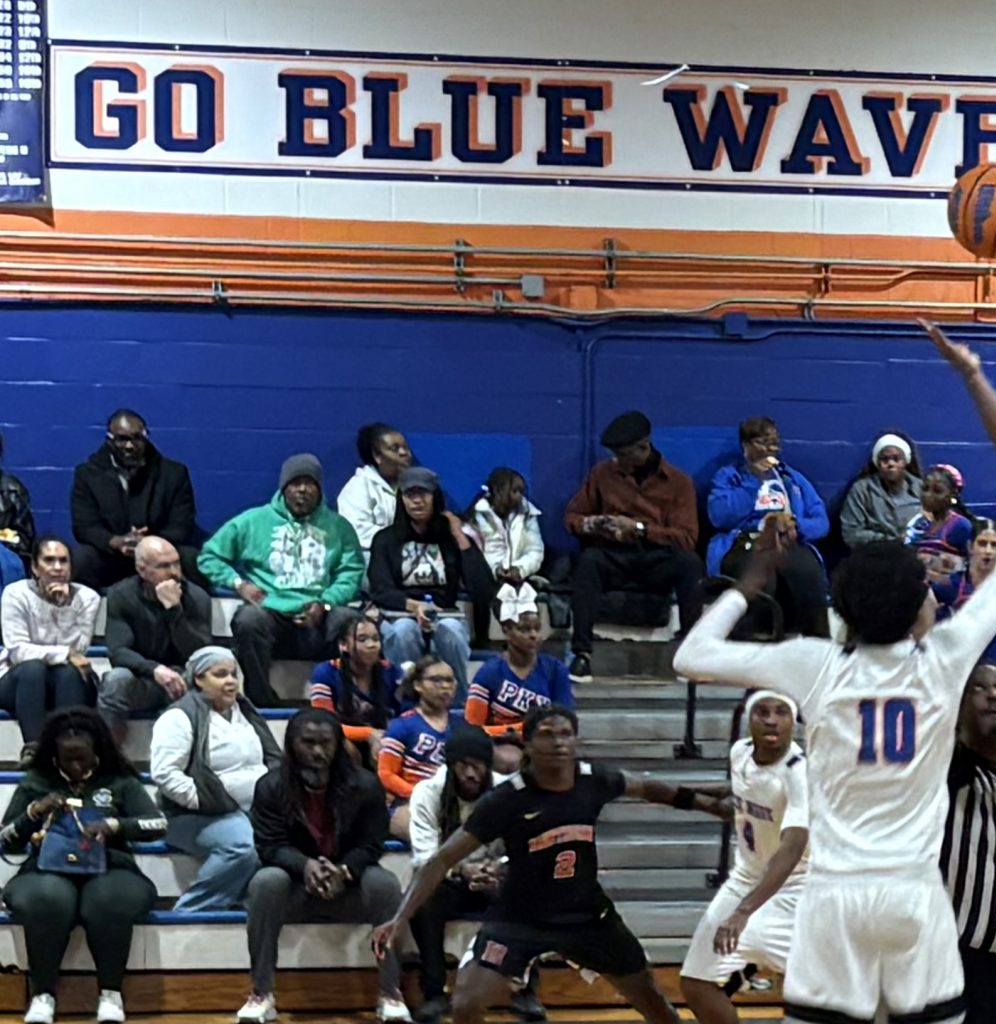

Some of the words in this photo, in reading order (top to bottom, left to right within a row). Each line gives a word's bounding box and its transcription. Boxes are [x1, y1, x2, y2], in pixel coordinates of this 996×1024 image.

[74, 60, 225, 153] GO
[277, 66, 612, 167] BLUE
[856, 698, 917, 765] 10
[553, 850, 577, 879] 2
